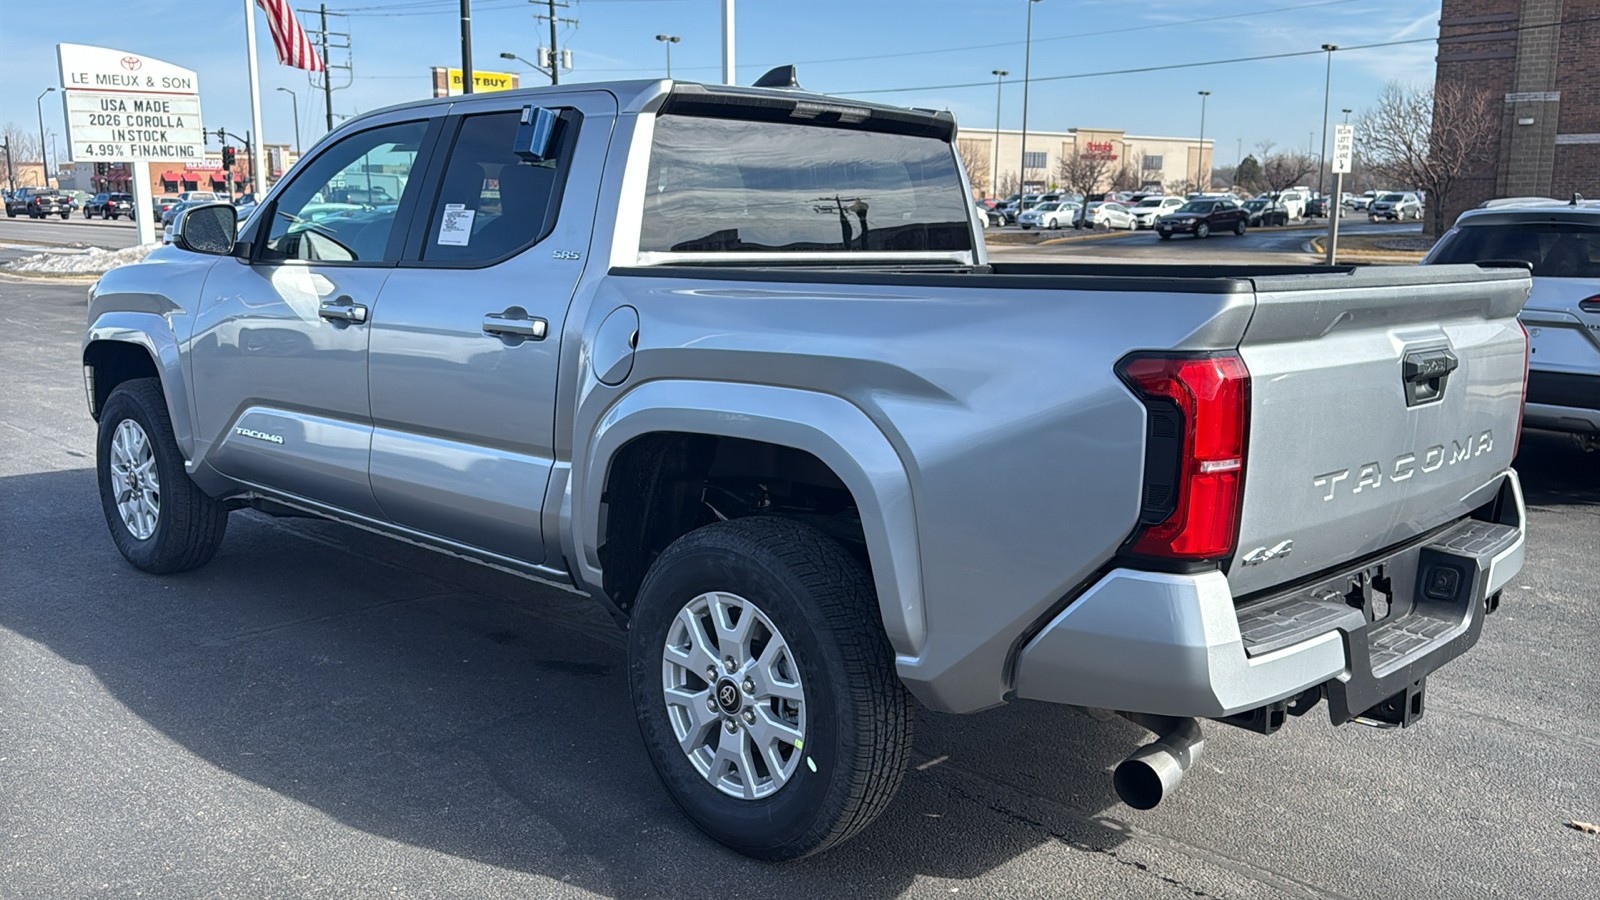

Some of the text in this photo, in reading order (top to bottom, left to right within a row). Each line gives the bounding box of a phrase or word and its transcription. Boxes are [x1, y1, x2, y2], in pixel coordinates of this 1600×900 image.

[71, 72, 191, 89] LE MIEUX & SON
[453, 76, 507, 88] BT BUY
[100, 98, 170, 113] USA MADE
[89, 113, 184, 128] 2026 COROLLA
[85, 144, 195, 157] 4.99% FINANCING
[235, 426, 284, 445] TACOMA
[1313, 428, 1494, 502] TACOMA
